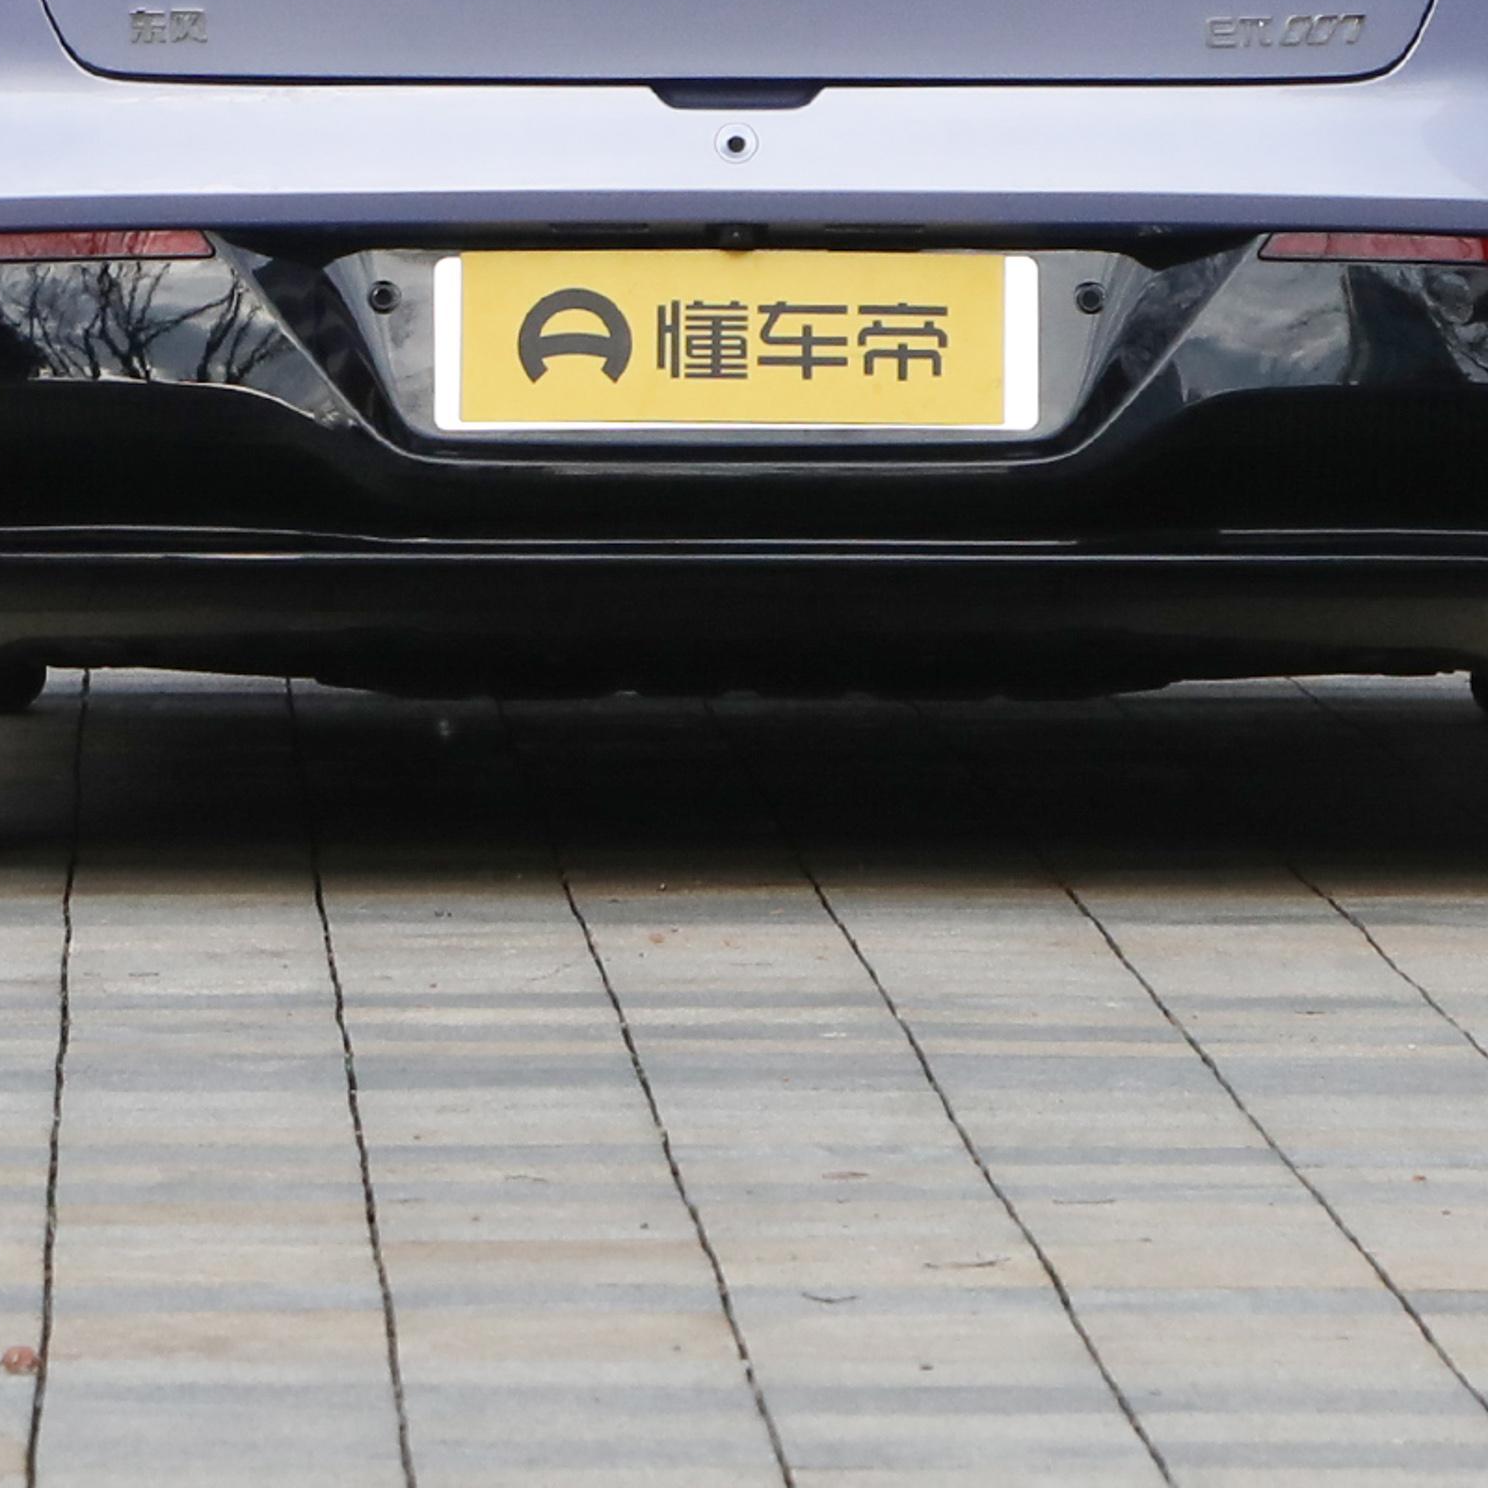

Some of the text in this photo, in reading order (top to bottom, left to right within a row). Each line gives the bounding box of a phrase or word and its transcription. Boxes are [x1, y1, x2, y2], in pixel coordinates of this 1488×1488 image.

[128, 7, 208, 43] 东风
[656, 299, 949, 382] 懂车帝
